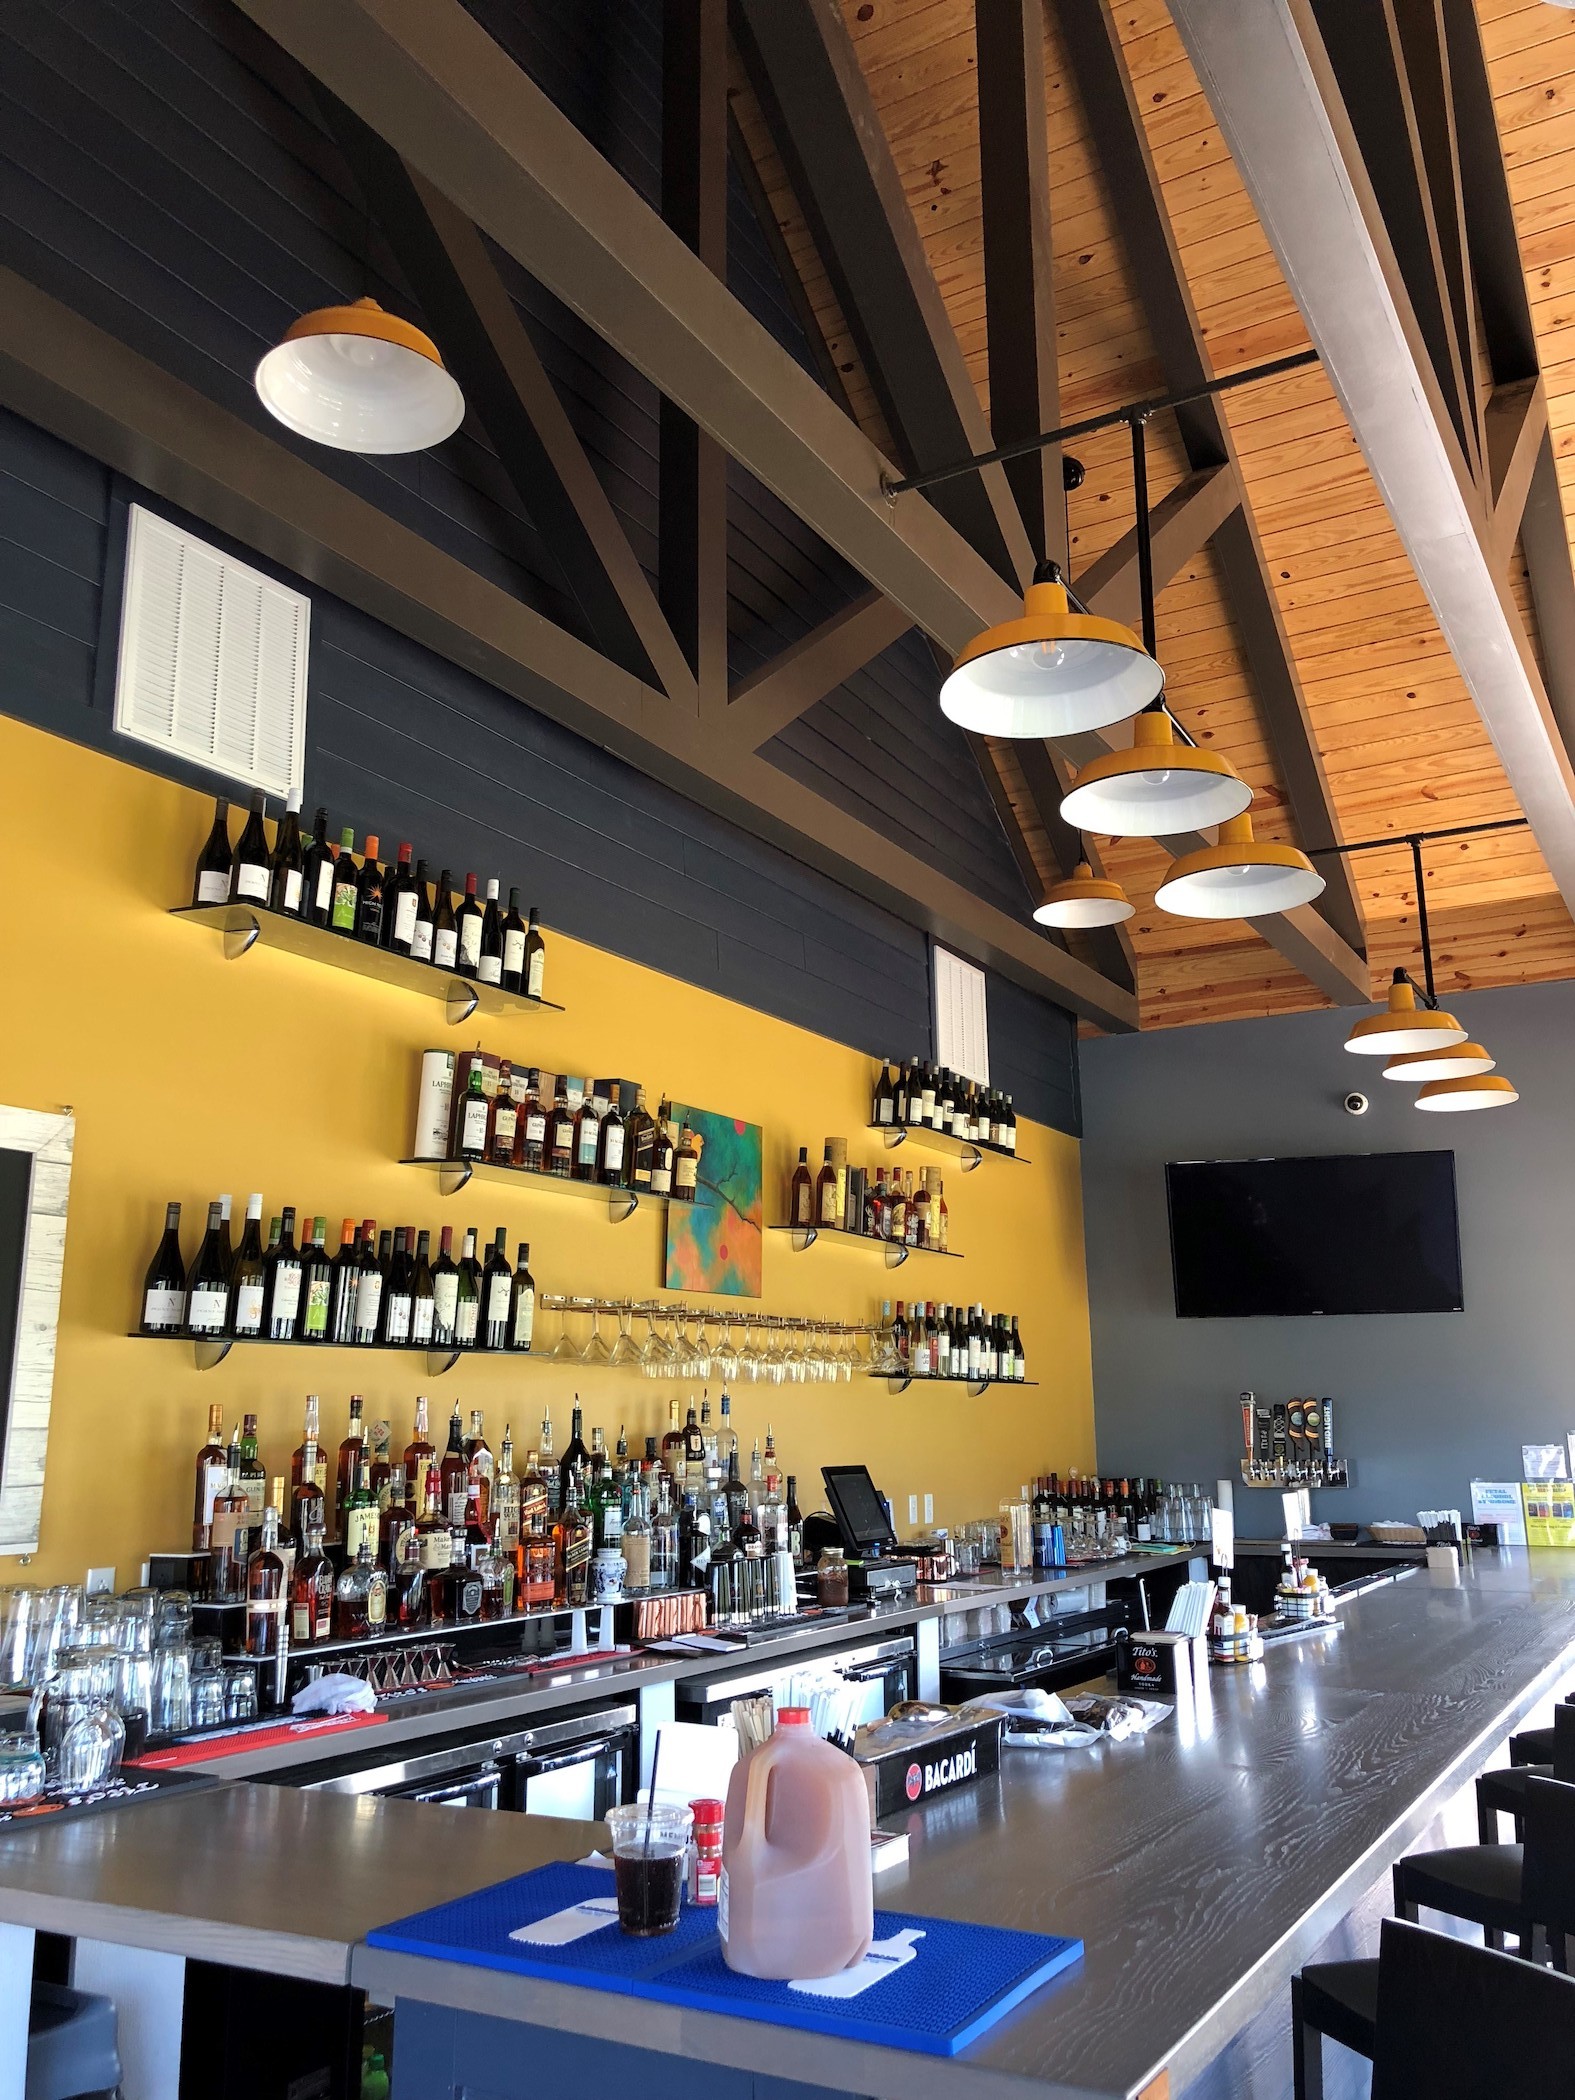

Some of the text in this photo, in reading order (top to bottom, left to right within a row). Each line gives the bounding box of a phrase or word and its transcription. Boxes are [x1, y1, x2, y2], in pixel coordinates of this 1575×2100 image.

[1323, 1405, 1332, 1449] BUD LIGHT
[1130, 1673, 1163, 1682] Handmade
